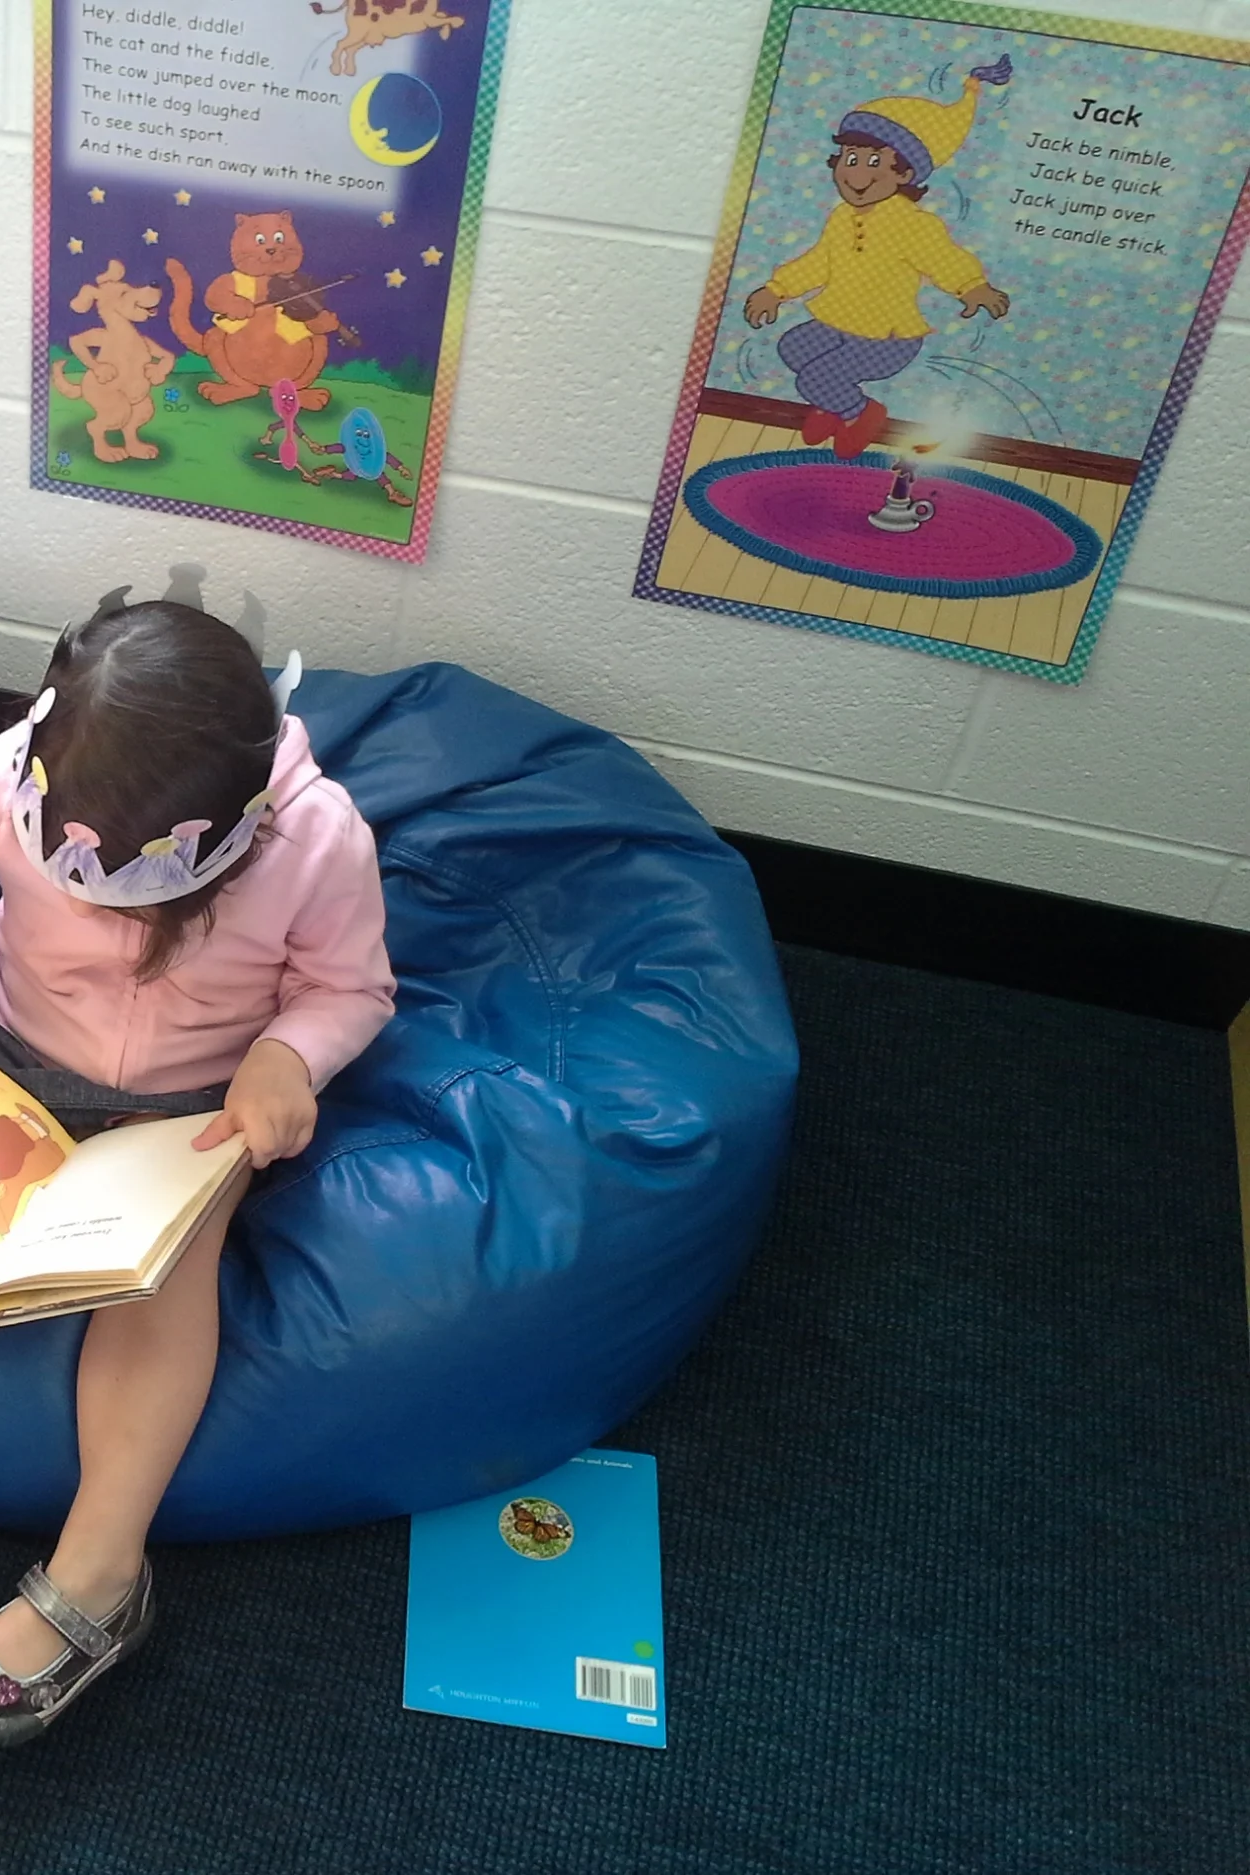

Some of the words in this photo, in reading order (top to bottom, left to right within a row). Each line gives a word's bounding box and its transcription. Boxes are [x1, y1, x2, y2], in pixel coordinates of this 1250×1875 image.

[187, 16, 244, 35] diddle!
[83, 30, 113, 47] The
[119, 38, 145, 50] cat
[151, 42, 179, 56] and
[187, 44, 213, 60] the
[221, 47, 274, 70] fiddle,
[82, 57, 112, 74] The
[118, 66, 148, 79] cow
[153, 68, 213, 88] jumped
[219, 79, 256, 92] over
[262, 81, 289, 98] the
[82, 84, 111, 101] The
[117, 89, 157, 108] little
[163, 96, 192, 116] dog
[198, 99, 261, 121] laughed
[1073, 98, 1143, 127] Jack
[81, 110, 99, 126] To
[105, 118, 132, 131] see
[138, 122, 174, 137] such
[80, 138, 110, 154] And
[116, 142, 143, 159] the
[148, 148, 181, 163] dish
[186, 155, 213, 168] ran
[218, 159, 257, 177] away
[263, 165, 298, 179] with
[305, 168, 332, 184] the
[337, 175, 388, 192] spoon.
[1026, 132, 1073, 152] Jack
[1079, 140, 1102, 157] be
[1108, 147, 1176, 172] nimble,
[1030, 163, 1077, 183] Jack
[1082, 170, 1105, 188] be
[1010, 188, 1055, 209] Jack
[1059, 198, 1106, 220] jump
[1112, 208, 1156, 225] over
[1014, 220, 1045, 237] the
[1051, 225, 1111, 247] candle
[1116, 236, 1169, 256] stick.
